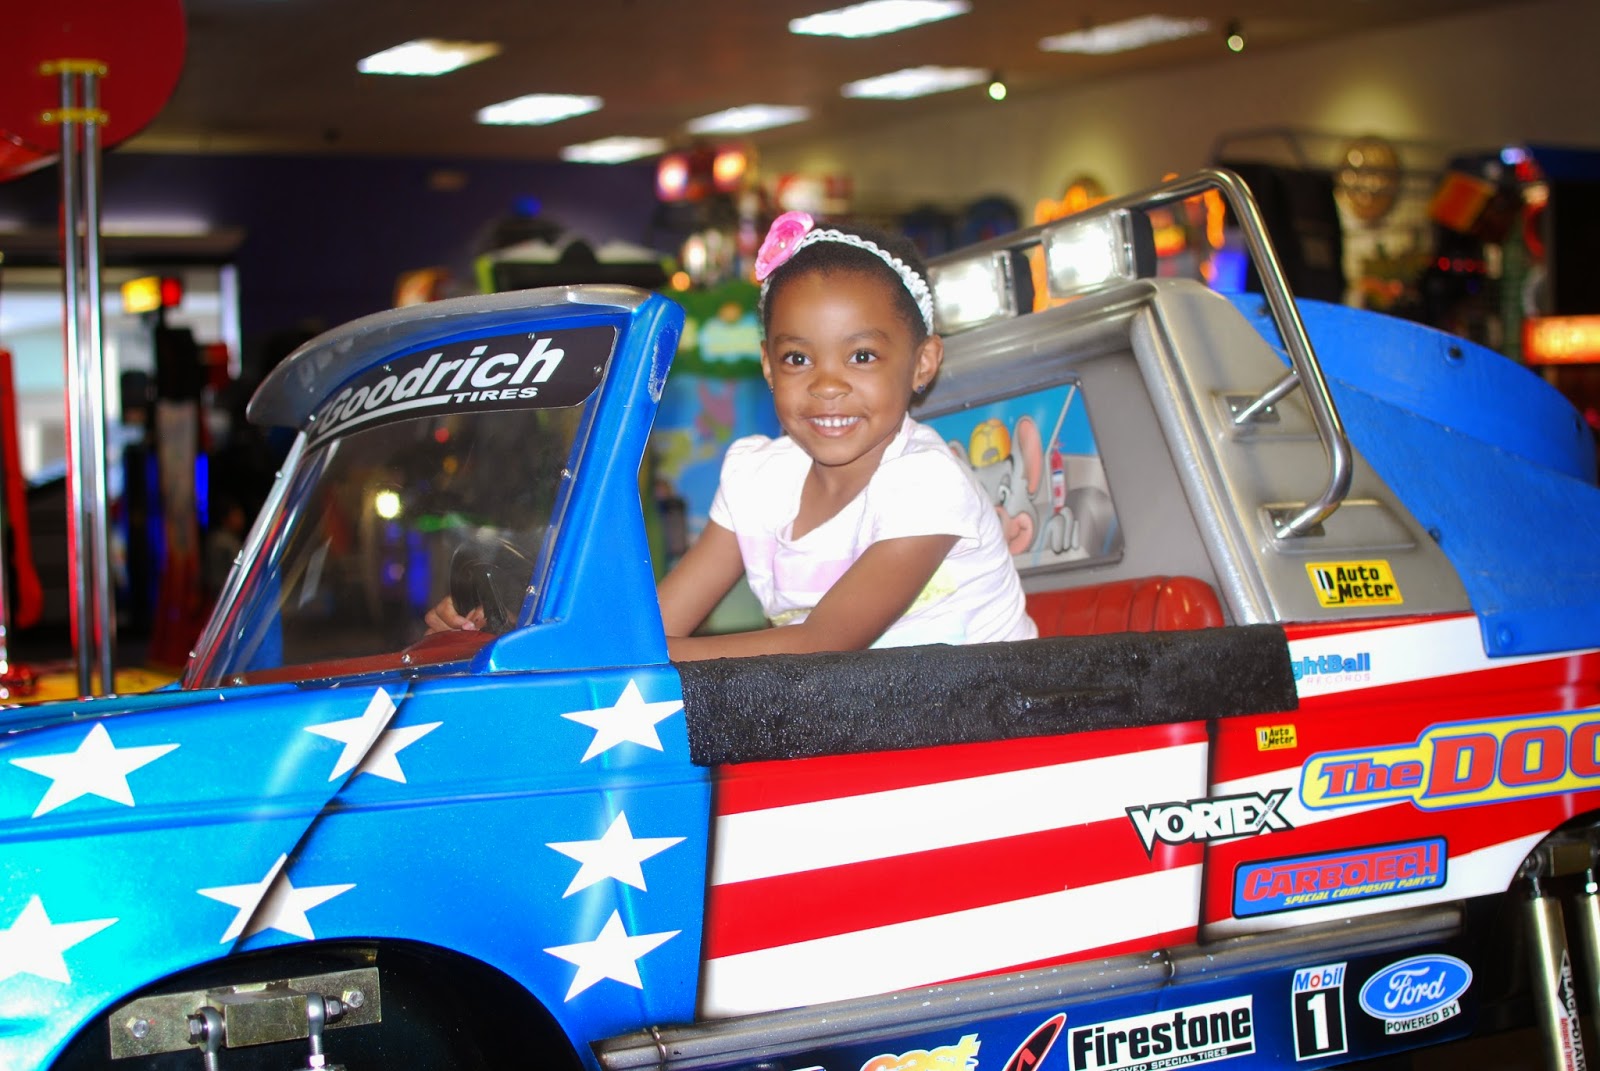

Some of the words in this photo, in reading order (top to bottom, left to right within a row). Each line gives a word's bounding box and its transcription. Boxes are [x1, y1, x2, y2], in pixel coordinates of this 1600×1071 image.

[452, 387, 539, 404] TIRES
[1336, 566, 1380, 582] Auto
[1337, 583, 1394, 602] Meter
[1306, 673, 1371, 685] RECORDS
[1268, 735, 1295, 748] Meter
[1269, 727, 1290, 738] Auto
[1319, 759, 1423, 798] The
[1125, 787, 1295, 861] VORTEX
[1243, 843, 1439, 901] CARBOTECH
[1284, 891, 1329, 906] SPECIAL
[1332, 880, 1396, 898] COMPOSITE
[1294, 967, 1344, 992] Mobil
[1384, 966, 1446, 1010] Ford
[1562, 967, 1577, 1018] BLACK
[1307, 993, 1329, 1050] 1
[1386, 1011, 1439, 1033] POWERED
[1441, 1003, 1457, 1018] BY
[1073, 1007, 1252, 1071] Firestone
[1151, 1055, 1195, 1070] SPECIAL
[1198, 1048, 1228, 1060] TIRES
